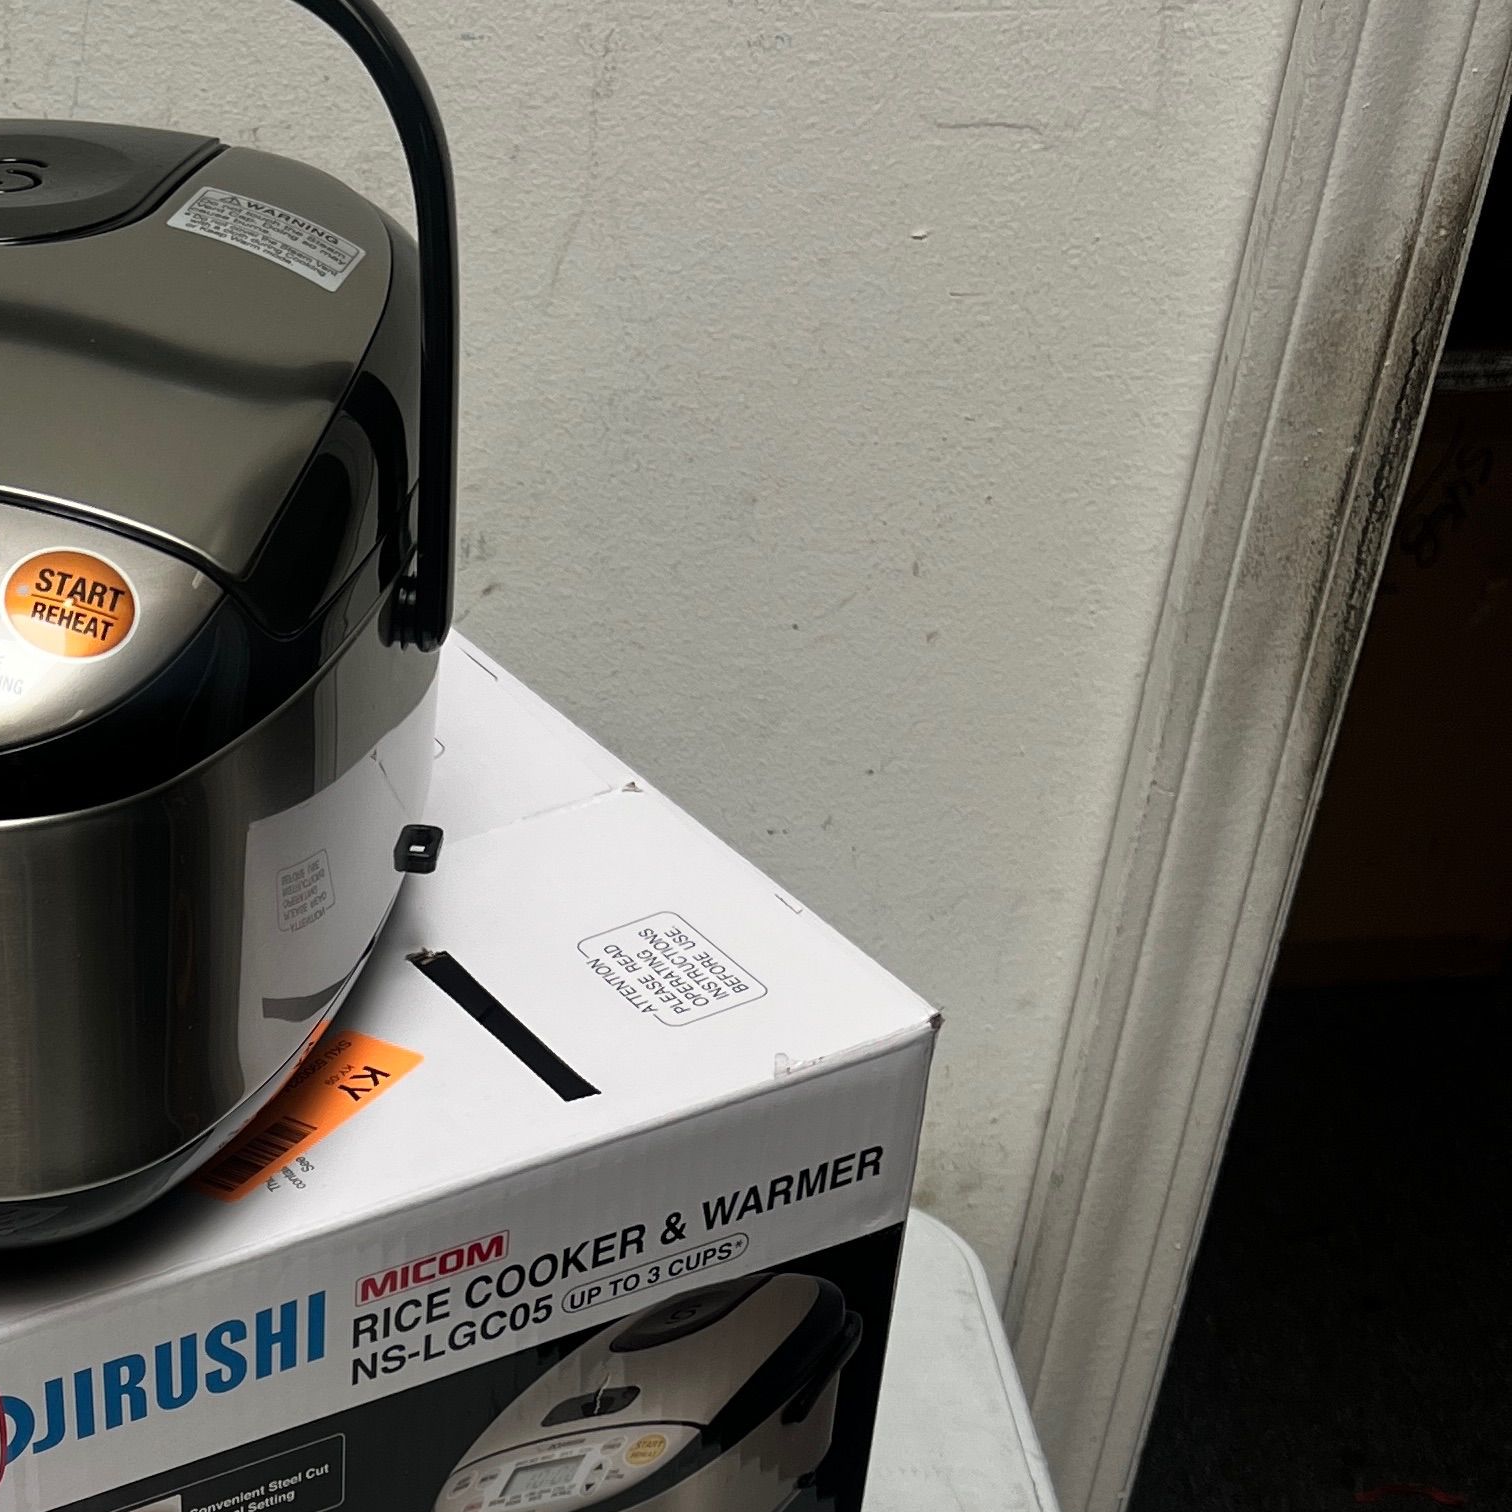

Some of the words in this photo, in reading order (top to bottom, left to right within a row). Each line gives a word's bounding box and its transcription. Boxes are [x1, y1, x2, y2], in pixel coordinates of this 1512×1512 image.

[247, 201, 339, 245] WARNING
[35, 568, 125, 612] START
[31, 601, 114, 642] REHEAT
[604, 944, 641, 973] READ
[636, 950, 709, 1007] OPERATING
[638, 928, 729, 1000] INSTRUCTIONS
[694, 952, 749, 994] BEFORE
[586, 958, 657, 1013] ATTENTION
[637, 974, 691, 1014] PLEASE
[338, 1066, 391, 1102] KY
[352, 1288, 450, 1348] RICE
[465, 1224, 645, 1308] COOKER
[660, 1211, 686, 1245] &
[703, 1146, 883, 1229] WARMER
[361, 1235, 504, 1301] MICOM
[352, 1294, 553, 1385] NS-LGC05
[568, 1283, 602, 1312] UP
[607, 1270, 641, 1299] TO
[646, 1263, 662, 1286] 3
[268, 1472, 302, 1492] Steel
[305, 1463, 330, 1480] Cut
